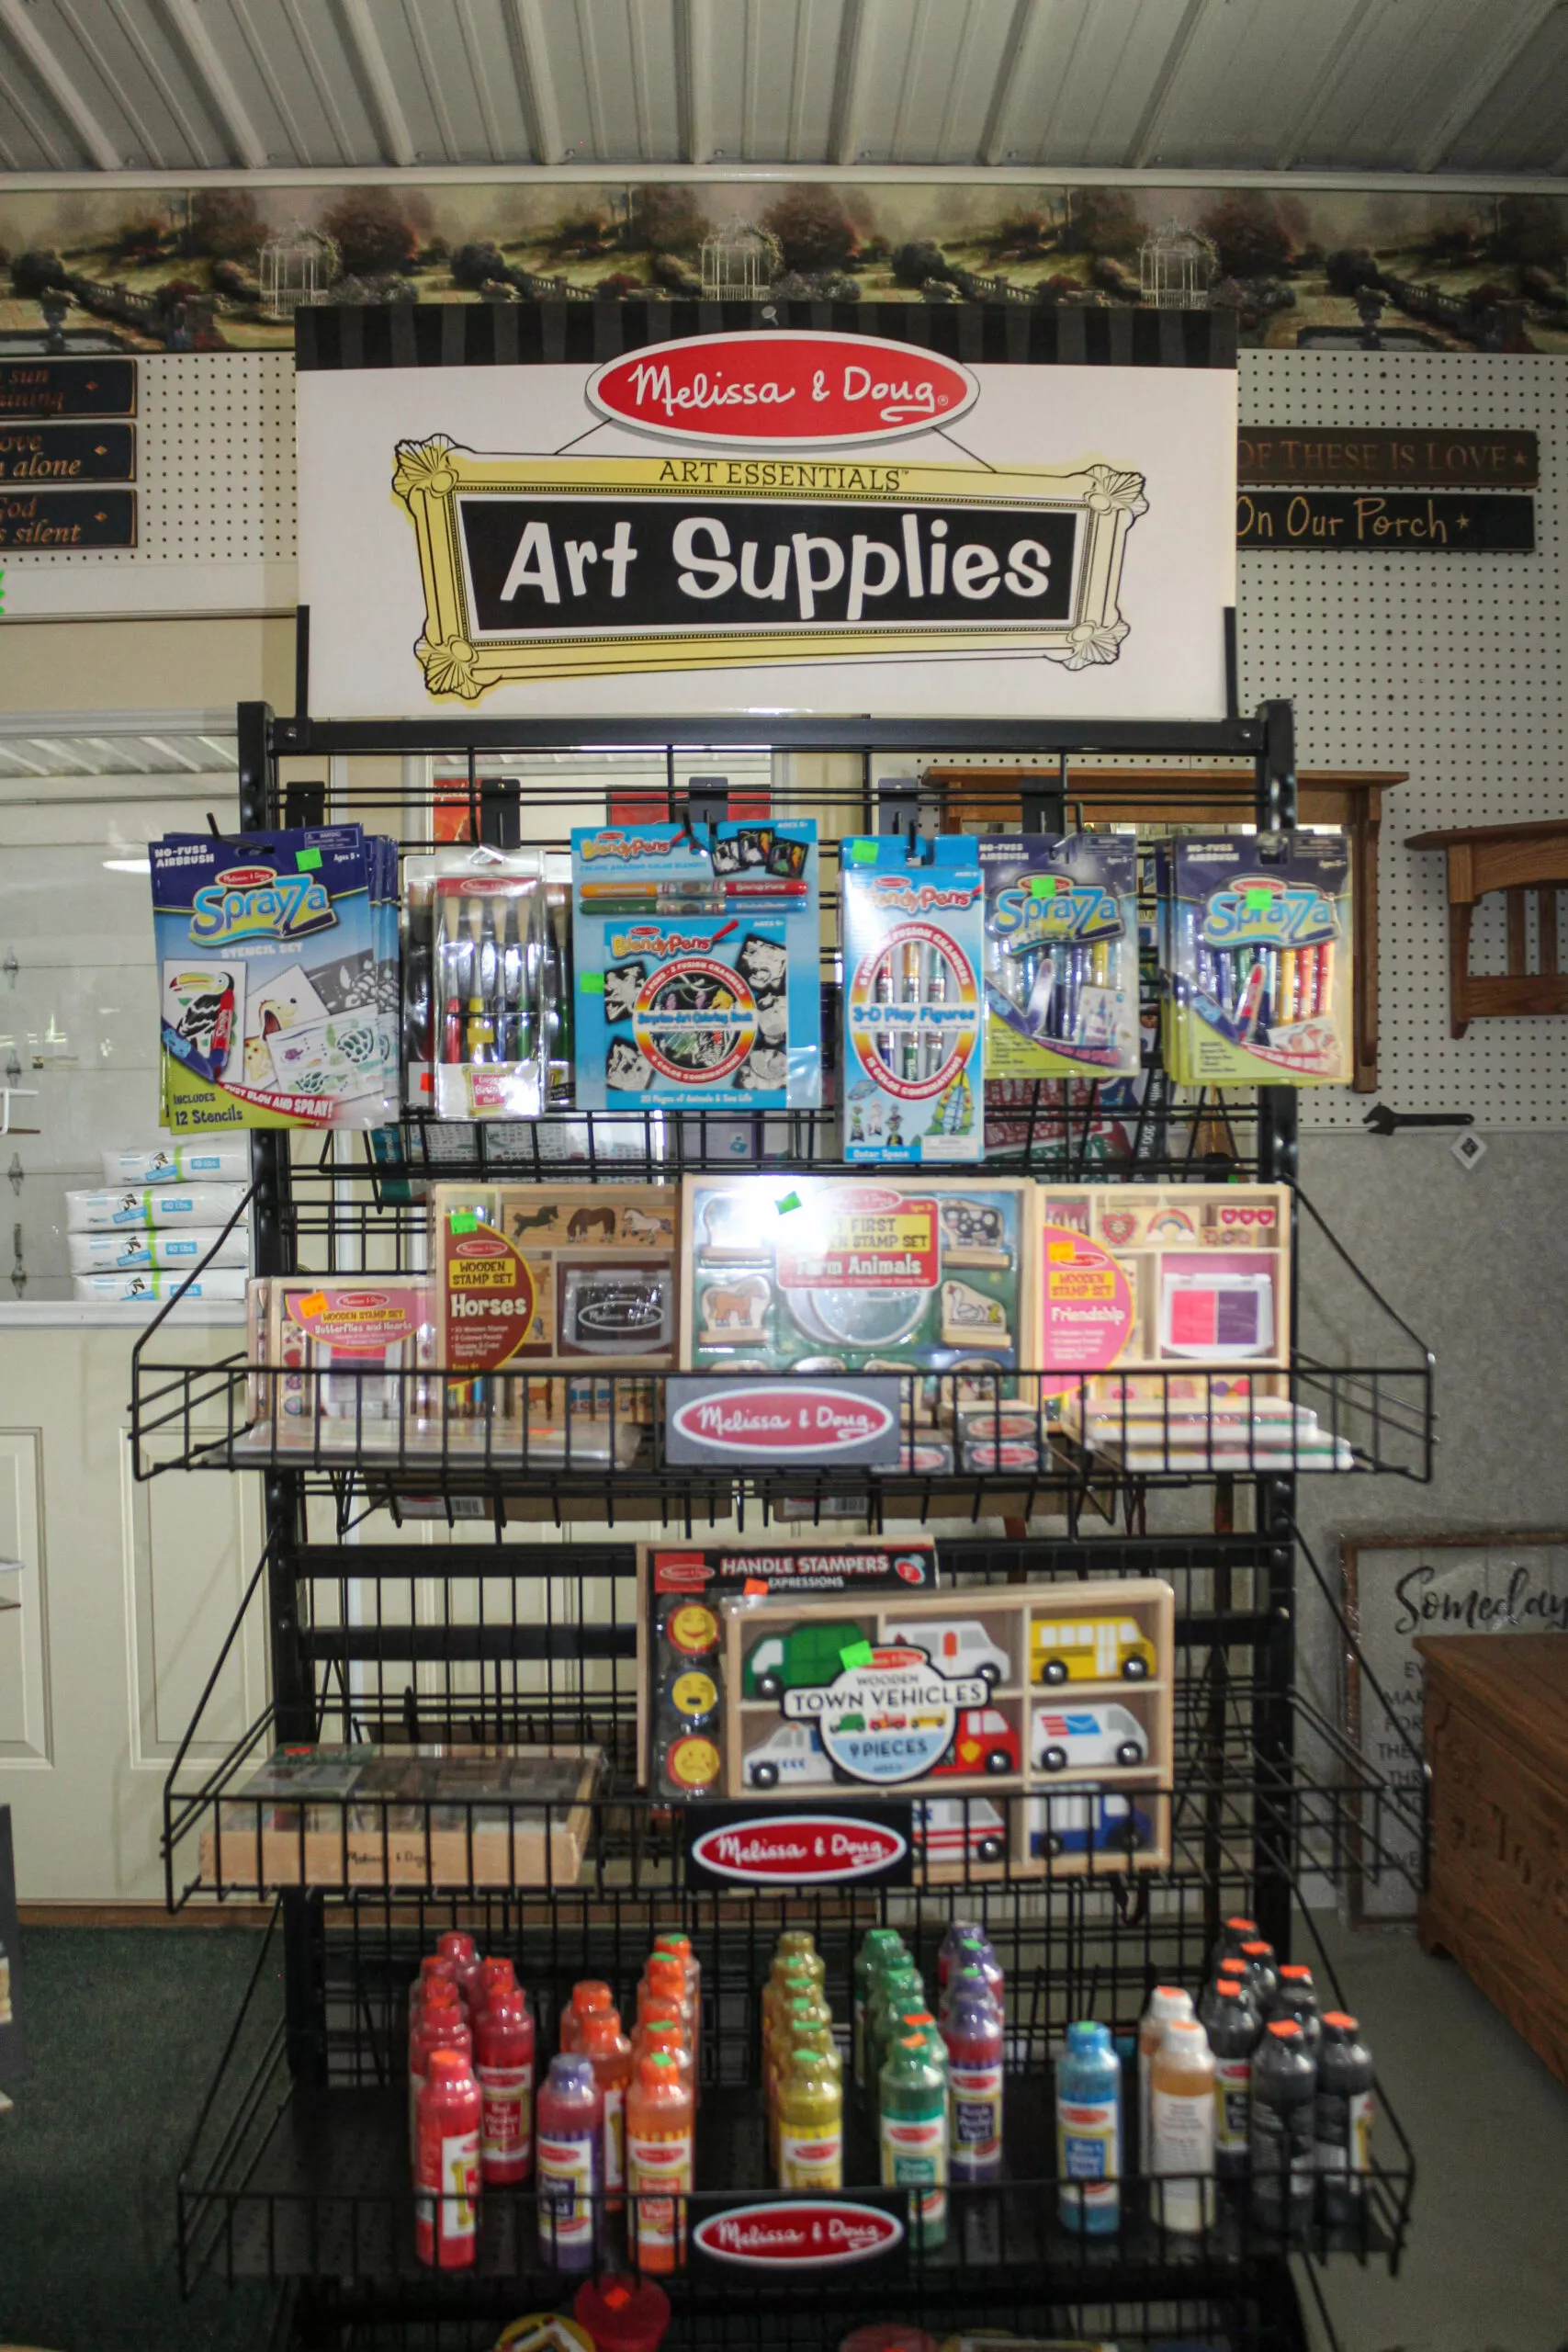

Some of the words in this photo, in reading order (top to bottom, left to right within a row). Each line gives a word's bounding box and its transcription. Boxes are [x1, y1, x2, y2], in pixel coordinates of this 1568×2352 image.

[628, 364, 795, 417] Melissa
[812, 370, 829, 402] &
[13, 452, 81, 476] alone
[659, 460, 718, 483] ART
[727, 462, 901, 492] ESSENTIALS
[1236, 496, 1274, 537] On
[1288, 496, 1344, 537] Our
[1353, 497, 1448, 543] Porch
[12, 518, 81, 544] silent
[499, 517, 637, 604] Art
[672, 514, 1052, 621] Supplies
[154, 844, 208, 858] NO-FUSS
[156, 854, 215, 868] AIRBRUSH
[279, 943, 303, 955] SET
[174, 1092, 216, 1105] INCLUDES
[273, 1097, 292, 1110] AND
[175, 1110, 188, 1126] 12
[193, 1104, 243, 1125] Stencils
[851, 1218, 897, 1232] FIRST
[852, 1236, 898, 1249] STAMP
[902, 1235, 928, 1248] SET
[459, 1261, 506, 1273] WOODEN
[848, 1253, 922, 1275] Animals
[452, 1273, 491, 1285] STAMP
[492, 1272, 513, 1284] SET
[323, 1312, 357, 1321] WOODEN
[450, 1293, 527, 1318] Horses
[314, 1323, 364, 1335] Butterflies
[366, 1323, 382, 1332] and
[383, 1321, 412, 1331] Hearts
[697, 1406, 791, 1436] Melissa
[798, 1407, 808, 1430] &
[721, 1556, 794, 1577] HANDLE
[797, 1555, 890, 1576] STAMPERS
[768, 1576, 844, 1589] EXPRESSIONS
[1394, 1565, 1568, 1636] Someday
[856, 1674, 919, 1687] WOODEN
[793, 1690, 864, 1713] TOWN
[871, 1683, 982, 1708] VEHICLES
[863, 1737, 928, 1758] PIECES
[716, 1835, 807, 1867] Melissa
[717, 2220, 806, 2249] Melissa
